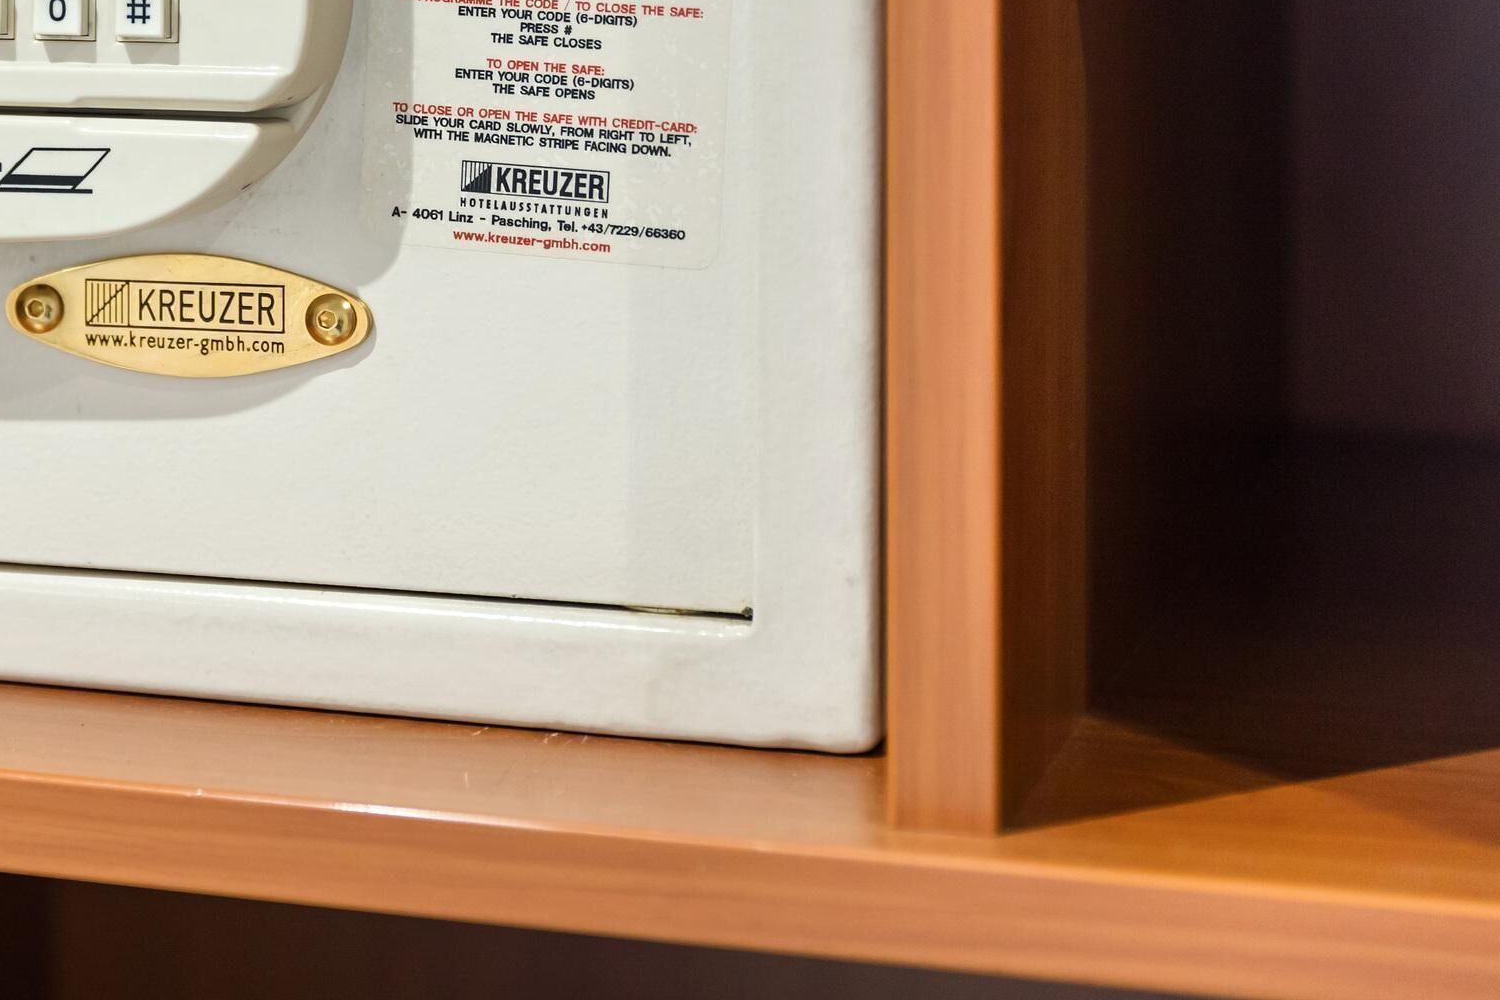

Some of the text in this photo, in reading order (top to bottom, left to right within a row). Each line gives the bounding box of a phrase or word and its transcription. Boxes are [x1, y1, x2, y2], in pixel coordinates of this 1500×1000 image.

[127, 0, 151, 24] #
[458, 5, 637, 27] ENTER YOUR CODE (6-DIGITS)
[575, 1, 590, 11] TO
[596, 2, 636, 14] CLOSE
[641, 5, 664, 15] THE
[670, 7, 703, 18] SAFE:
[520, 22, 572, 35] PRESS #
[491, 32, 601, 49] THE SAFE CLOSES
[486, 58, 604, 75] TO OPEN THE SAFE:
[455, 68, 633, 90] ENTER YOUR CODE (6-DIGITS)
[492, 83, 595, 99] THE SAFE OPENS
[393, 102, 697, 133] TO CLOSE OR OPEN THE SAFE WITH CREDIT-CARD:
[396, 114, 691, 146] SLIDE YOUR CARD SLOWLY, FROM RIGHT TO LEFT,
[414, 128, 670, 156] WITH THE MAGNETIC STRIPE FACING DOWN.
[496, 167, 605, 200] KREUZER
[460, 197, 607, 218] HOTELAUSSTATTUNGEN
[412, 208, 443, 220] 4061
[449, 211, 473, 223] Linz
[492, 214, 551, 231] Pasching,
[557, 220, 577, 232] Tel.
[582, 223, 685, 240] +43/7229/66360
[453, 230, 611, 253] www.kreuzer-gmbh.com
[138, 289, 276, 326] KREUZER
[85, 332, 285, 355] www.kreuzer-gmbh.com
